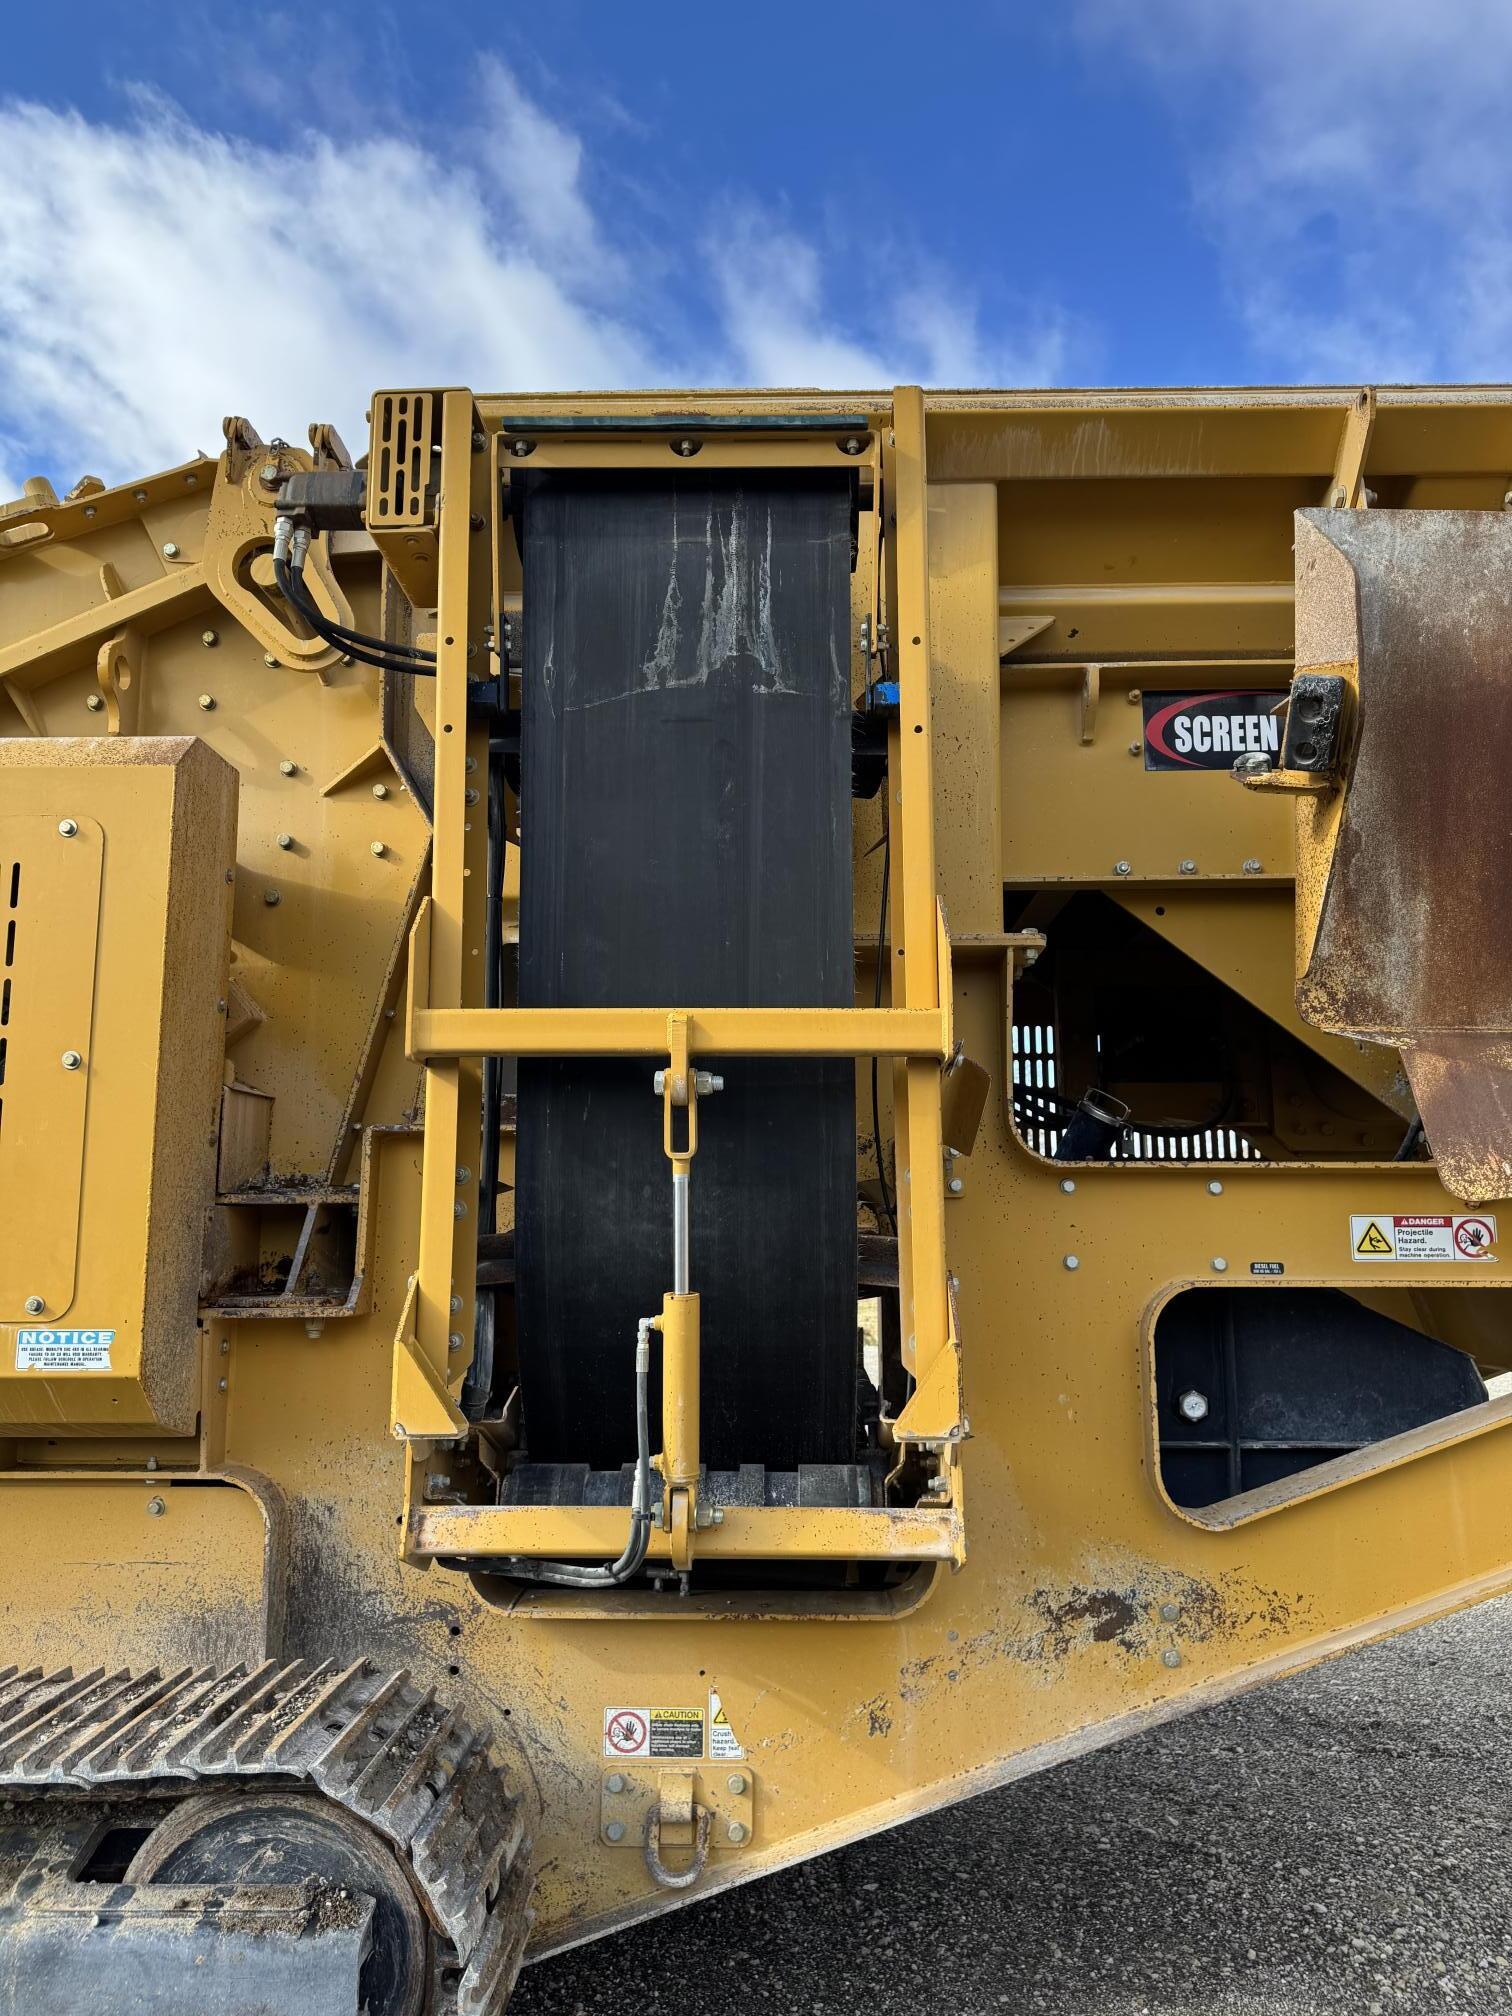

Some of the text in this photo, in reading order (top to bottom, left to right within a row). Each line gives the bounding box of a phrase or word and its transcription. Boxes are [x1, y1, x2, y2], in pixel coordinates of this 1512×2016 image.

[1174, 715, 1278, 753] SCREEN
[22, 1331, 112, 1344] NOTICE
[663, 1710, 699, 1719] CAUTION
